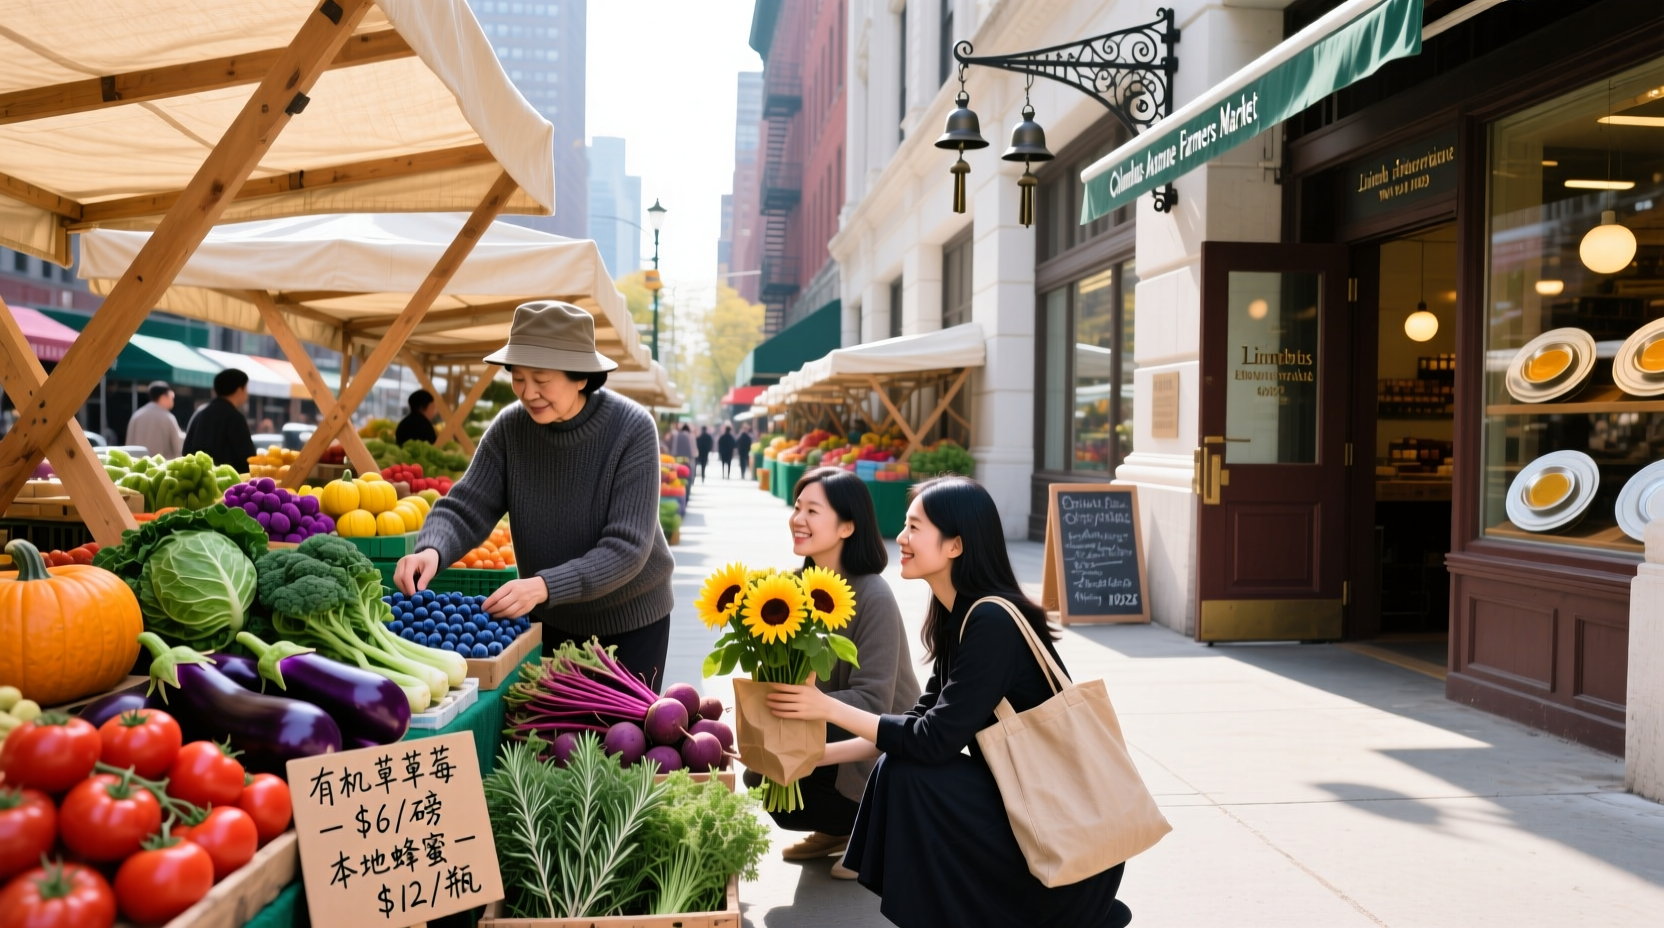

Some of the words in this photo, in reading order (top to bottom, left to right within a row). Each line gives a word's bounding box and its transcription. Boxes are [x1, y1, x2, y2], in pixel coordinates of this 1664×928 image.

[1219, 91, 1258, 138] Market
[310, 745, 457, 806] 有机草草莓
[355, 790, 442, 839] $6/磅
[330, 832, 447, 889] 本地蜂蜜
[377, 864, 482, 918] $12/瓶
